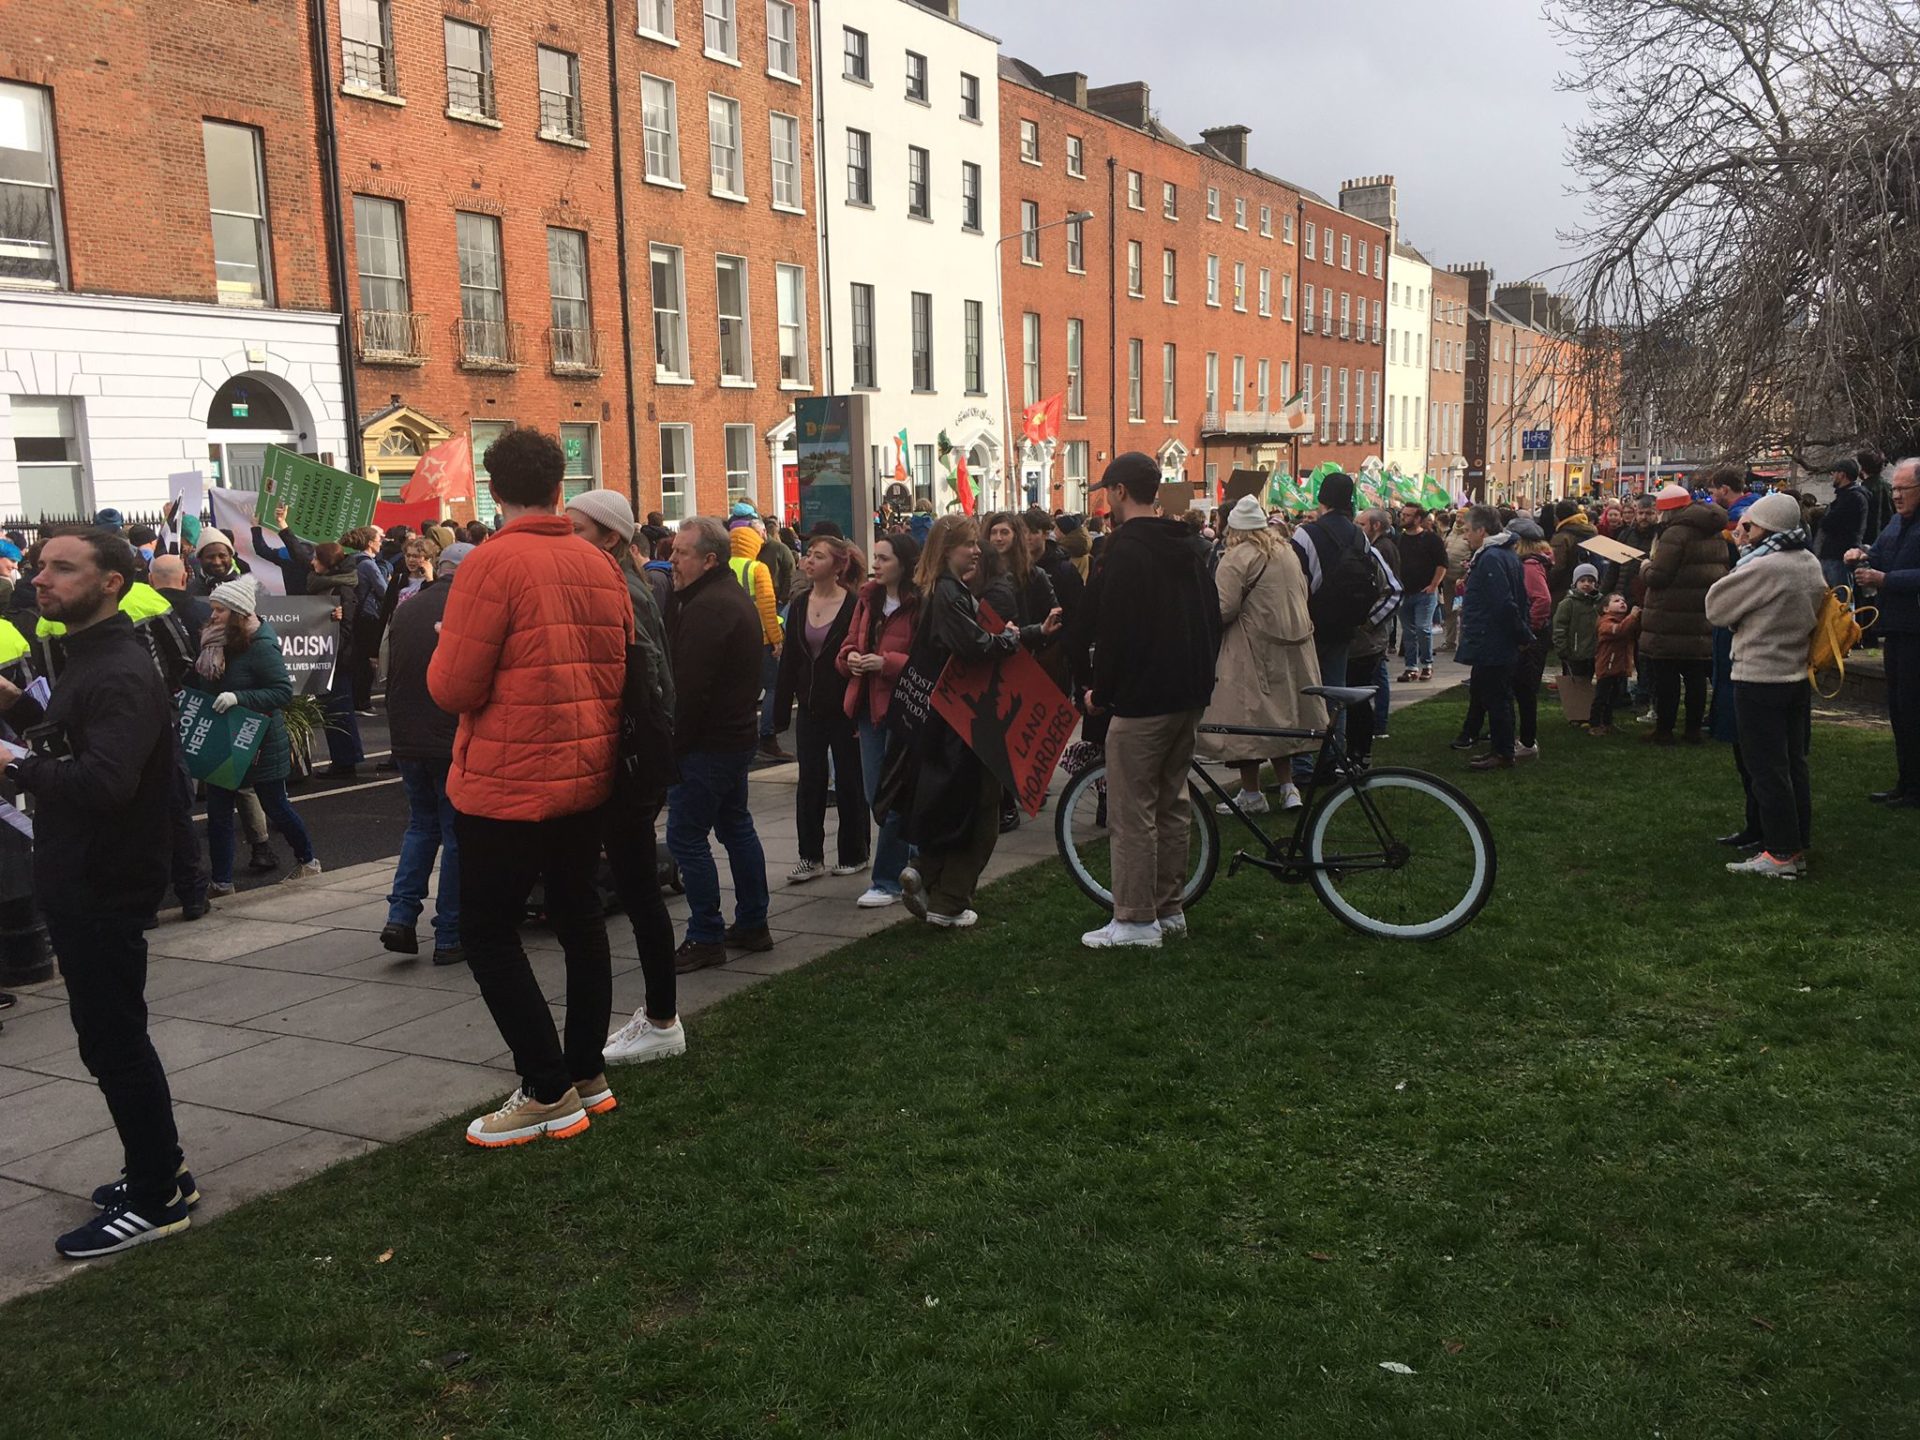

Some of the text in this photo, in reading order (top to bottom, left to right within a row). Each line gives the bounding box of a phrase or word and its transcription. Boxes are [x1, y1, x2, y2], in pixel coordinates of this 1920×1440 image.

[1477, 327, 1487, 403] CASSIDYS
[1475, 407, 1485, 455] HOTEL
[289, 484, 299, 509] NEED
[295, 474, 311, 526] INCREASED
[303, 472, 323, 536] ENGAGEMENT
[316, 478, 332, 527] IMPROVED
[325, 486, 341, 537] OUTCOMES
[335, 481, 354, 537] ADDICTION
[349, 498, 362, 530] RVICES
[260, 614, 300, 622] RANCH
[277, 635, 334, 656] ACISM
[292, 662, 309, 671] LIVES
[310, 662, 332, 670] MATTER
[180, 695, 204, 744] COME
[185, 717, 213, 755] HERE
[1014, 702, 1048, 760] LAND
[1022, 703, 1074, 810] HOARDERS
